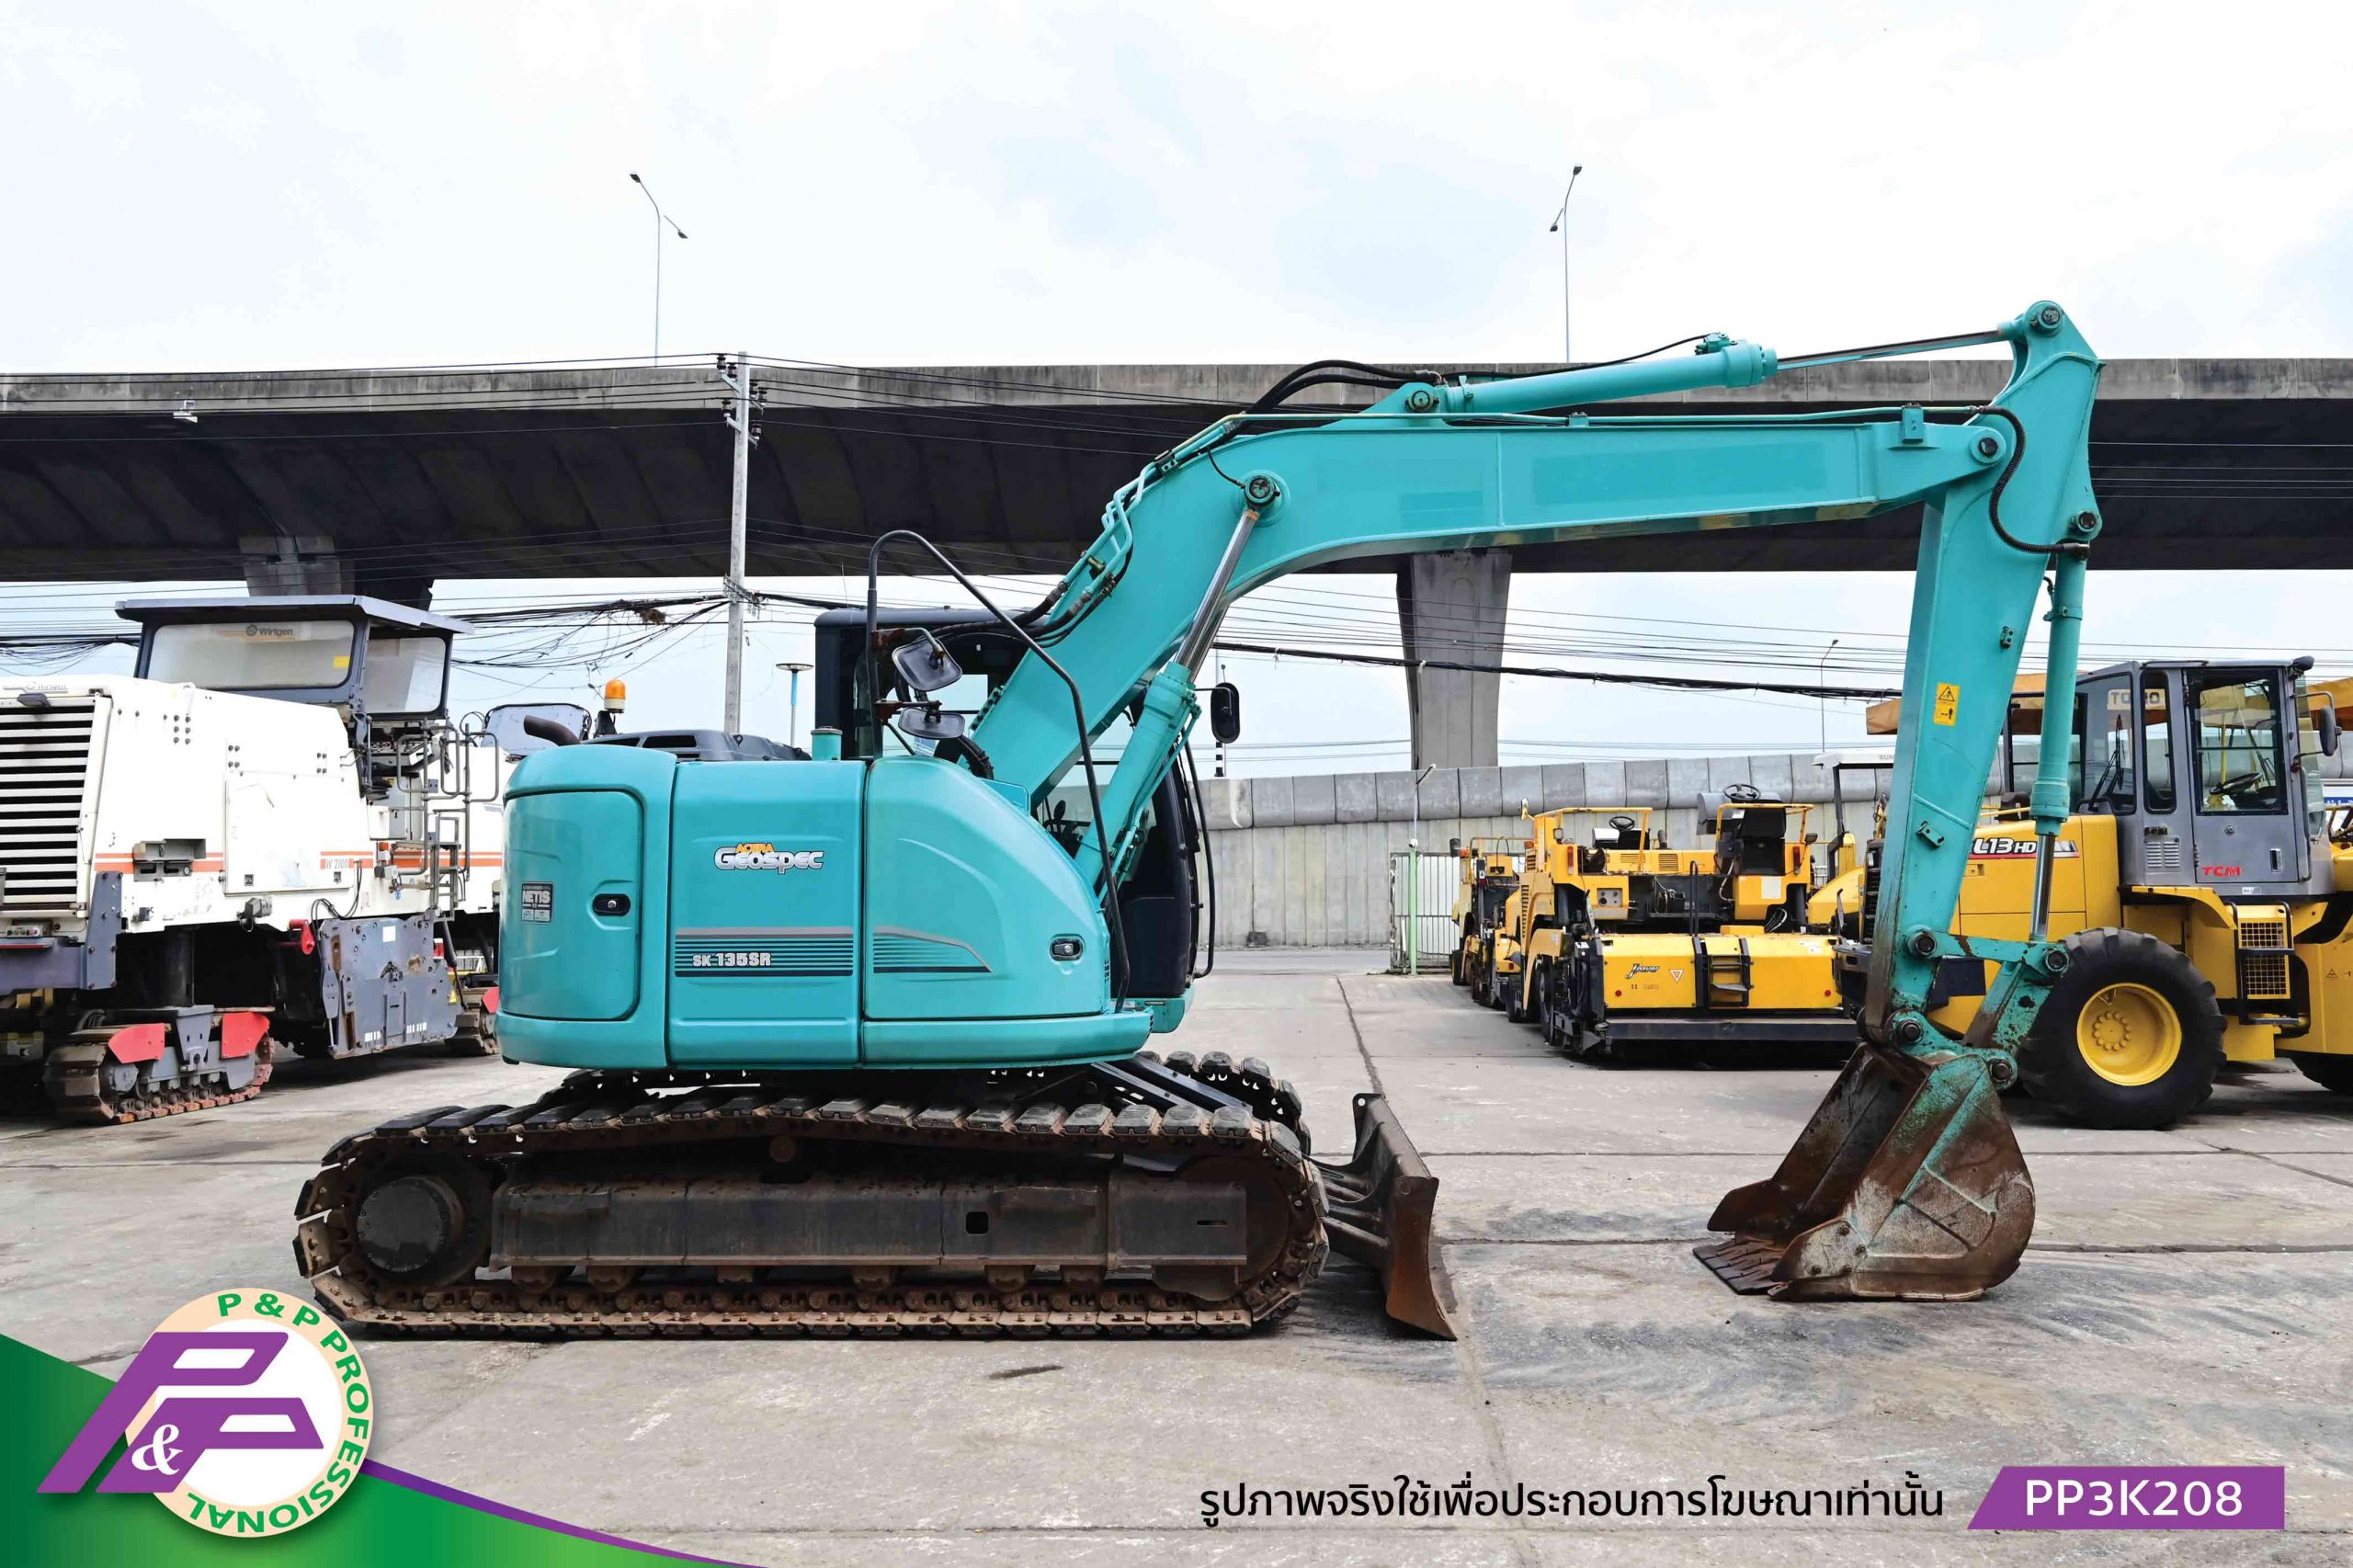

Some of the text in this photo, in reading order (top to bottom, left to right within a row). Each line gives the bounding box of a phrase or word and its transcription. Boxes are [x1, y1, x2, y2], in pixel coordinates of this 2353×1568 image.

[2202, 866, 2242, 877] TCM
[692, 952, 771, 967] SK 135SR
